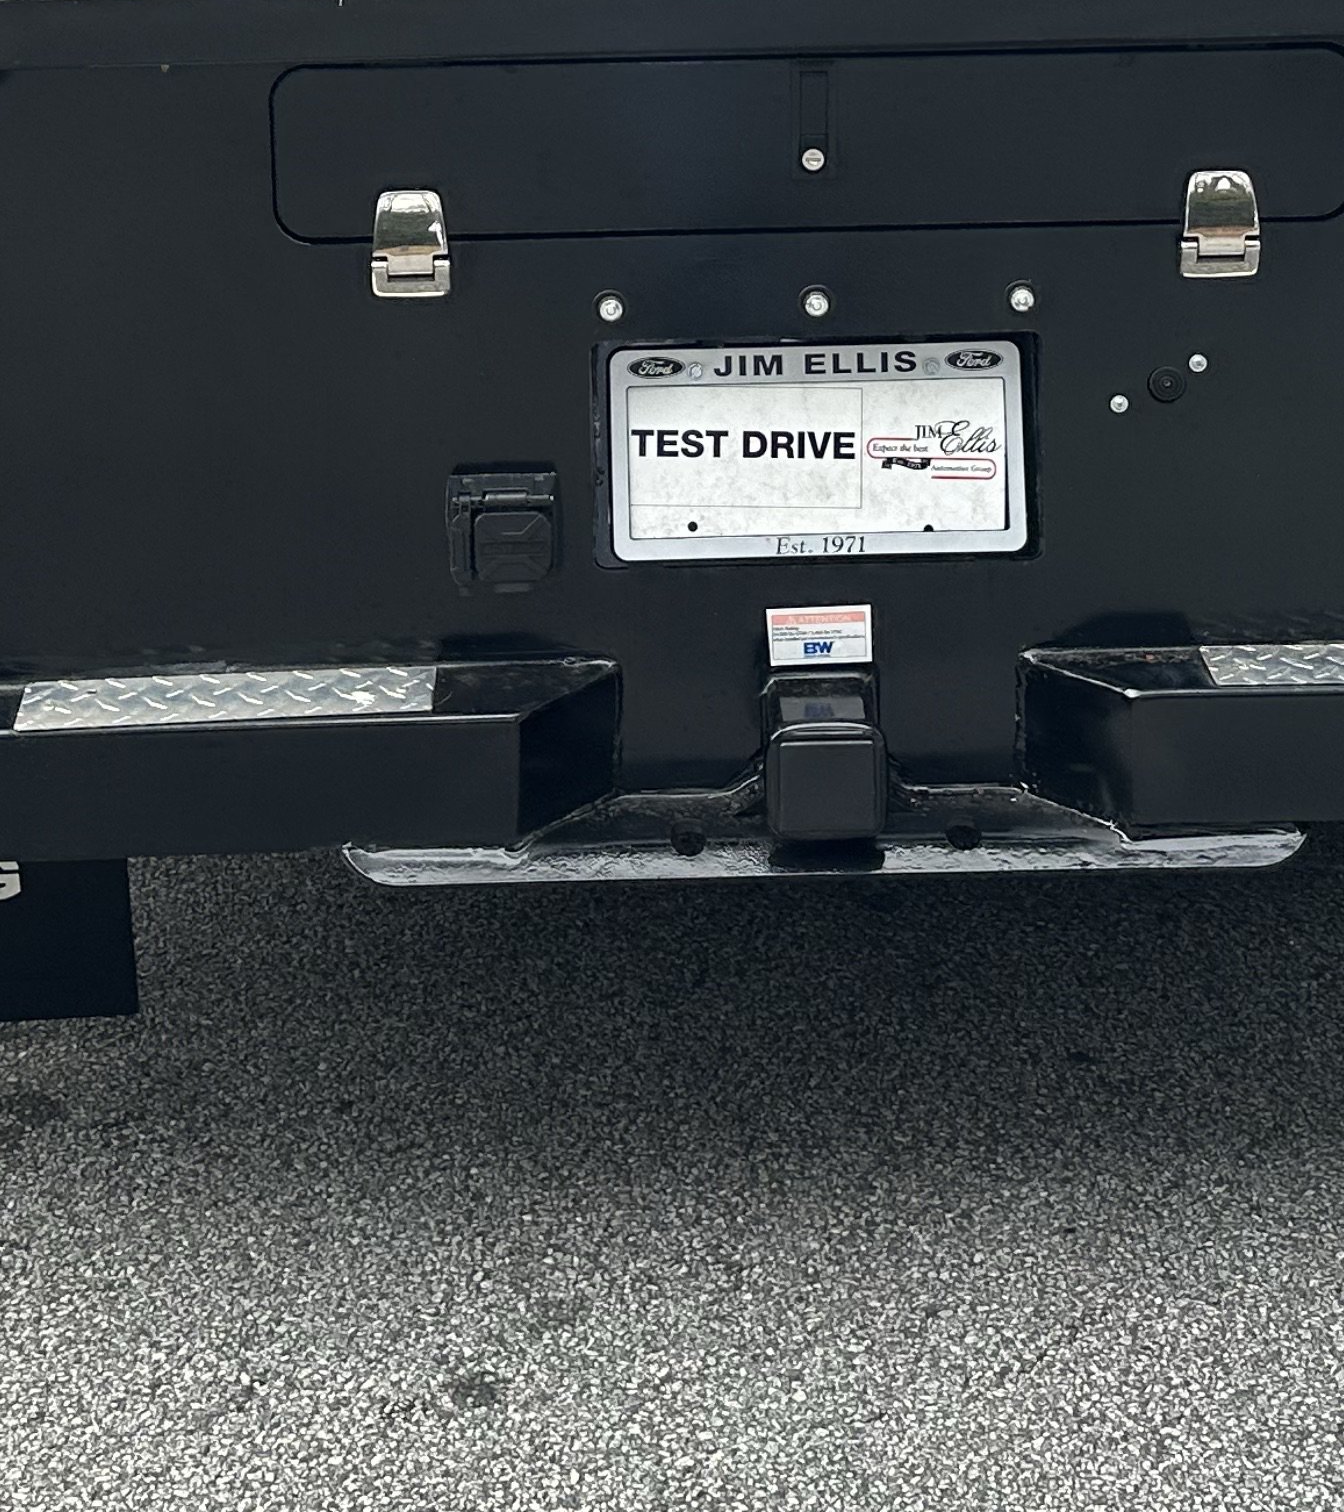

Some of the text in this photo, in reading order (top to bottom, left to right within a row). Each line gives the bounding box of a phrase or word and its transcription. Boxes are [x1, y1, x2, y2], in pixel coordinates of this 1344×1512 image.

[638, 360, 674, 375] Ford
[714, 351, 917, 376] JIM ELLIS
[956, 351, 992, 367] Ford
[631, 429, 856, 459] TEST DRIVE
[900, 443, 912, 452] the
[913, 443, 929, 452] best
[915, 420, 1002, 456] JIM Ellis
[776, 535, 866, 555] Est. 1971
